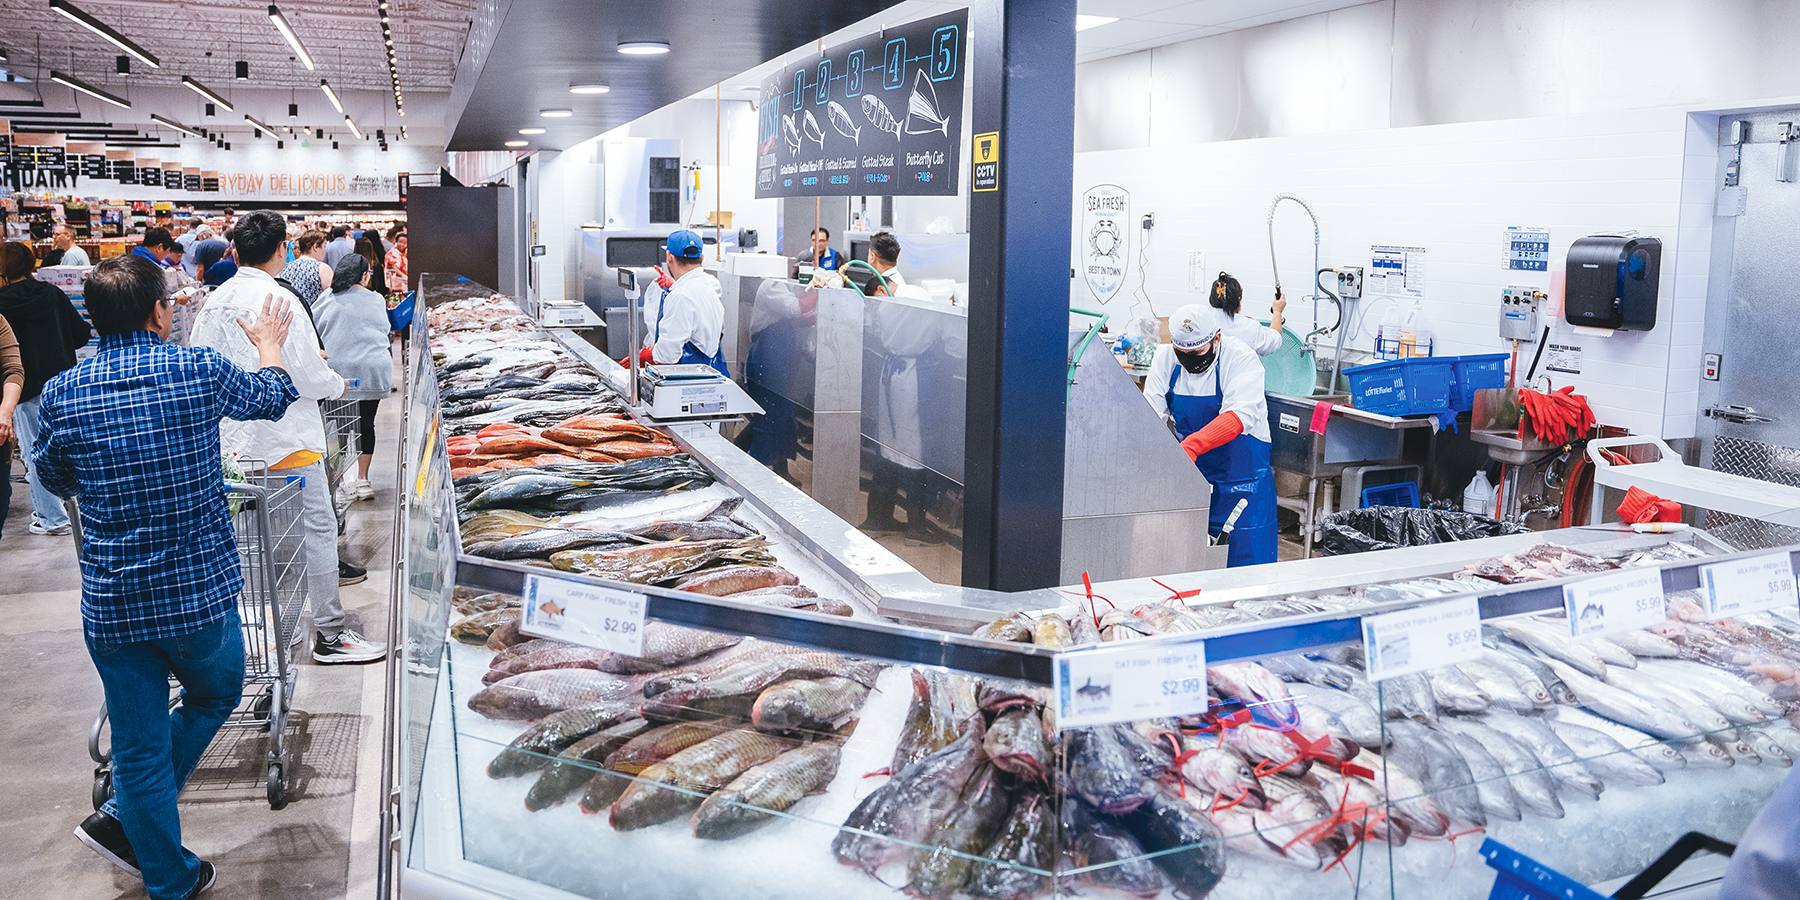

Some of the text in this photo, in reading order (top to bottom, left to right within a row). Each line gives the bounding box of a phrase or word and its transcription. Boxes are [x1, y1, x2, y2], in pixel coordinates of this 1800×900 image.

[937, 32, 951, 74] 5
[889, 44, 900, 83] 4
[819, 66, 828, 99] 2
[850, 57, 860, 91] 3
[796, 75, 802, 106] 1
[759, 95, 780, 145] FISH
[825, 157, 839, 171] Gutted
[861, 153, 895, 168] Gutted Steak
[906, 150, 945, 168] Butterfly Cut
[22, 169, 77, 188] DAIRY
[976, 165, 995, 178] CCTV
[270, 173, 346, 191] DELICIOUS
[979, 178, 995, 186] operation
[1088, 195, 1125, 212] SEA FRESH
[1088, 265, 1121, 276] BEST IN TOWN
[1187, 335, 1210, 348] MADRID
[1737, 566, 1748, 575] MILK
[1749, 565, 1760, 573] FISH
[1763, 562, 1779, 571] FRESH
[1627, 578, 1648, 590] FROZEN
[1768, 579, 1792, 594] $5.99
[566, 589, 583, 599] CARP
[585, 592, 600, 601] FISH
[605, 595, 627, 606] FRESH
[1636, 596, 1661, 612] $5.99
[604, 617, 637, 635] $2.99
[1447, 629, 1477, 647] $6.99
[1114, 659, 1131, 669] CAT
[1133, 657, 1150, 667] FISH
[1157, 655, 1183, 665] FRESH
[1162, 678, 1200, 696] $2.99
